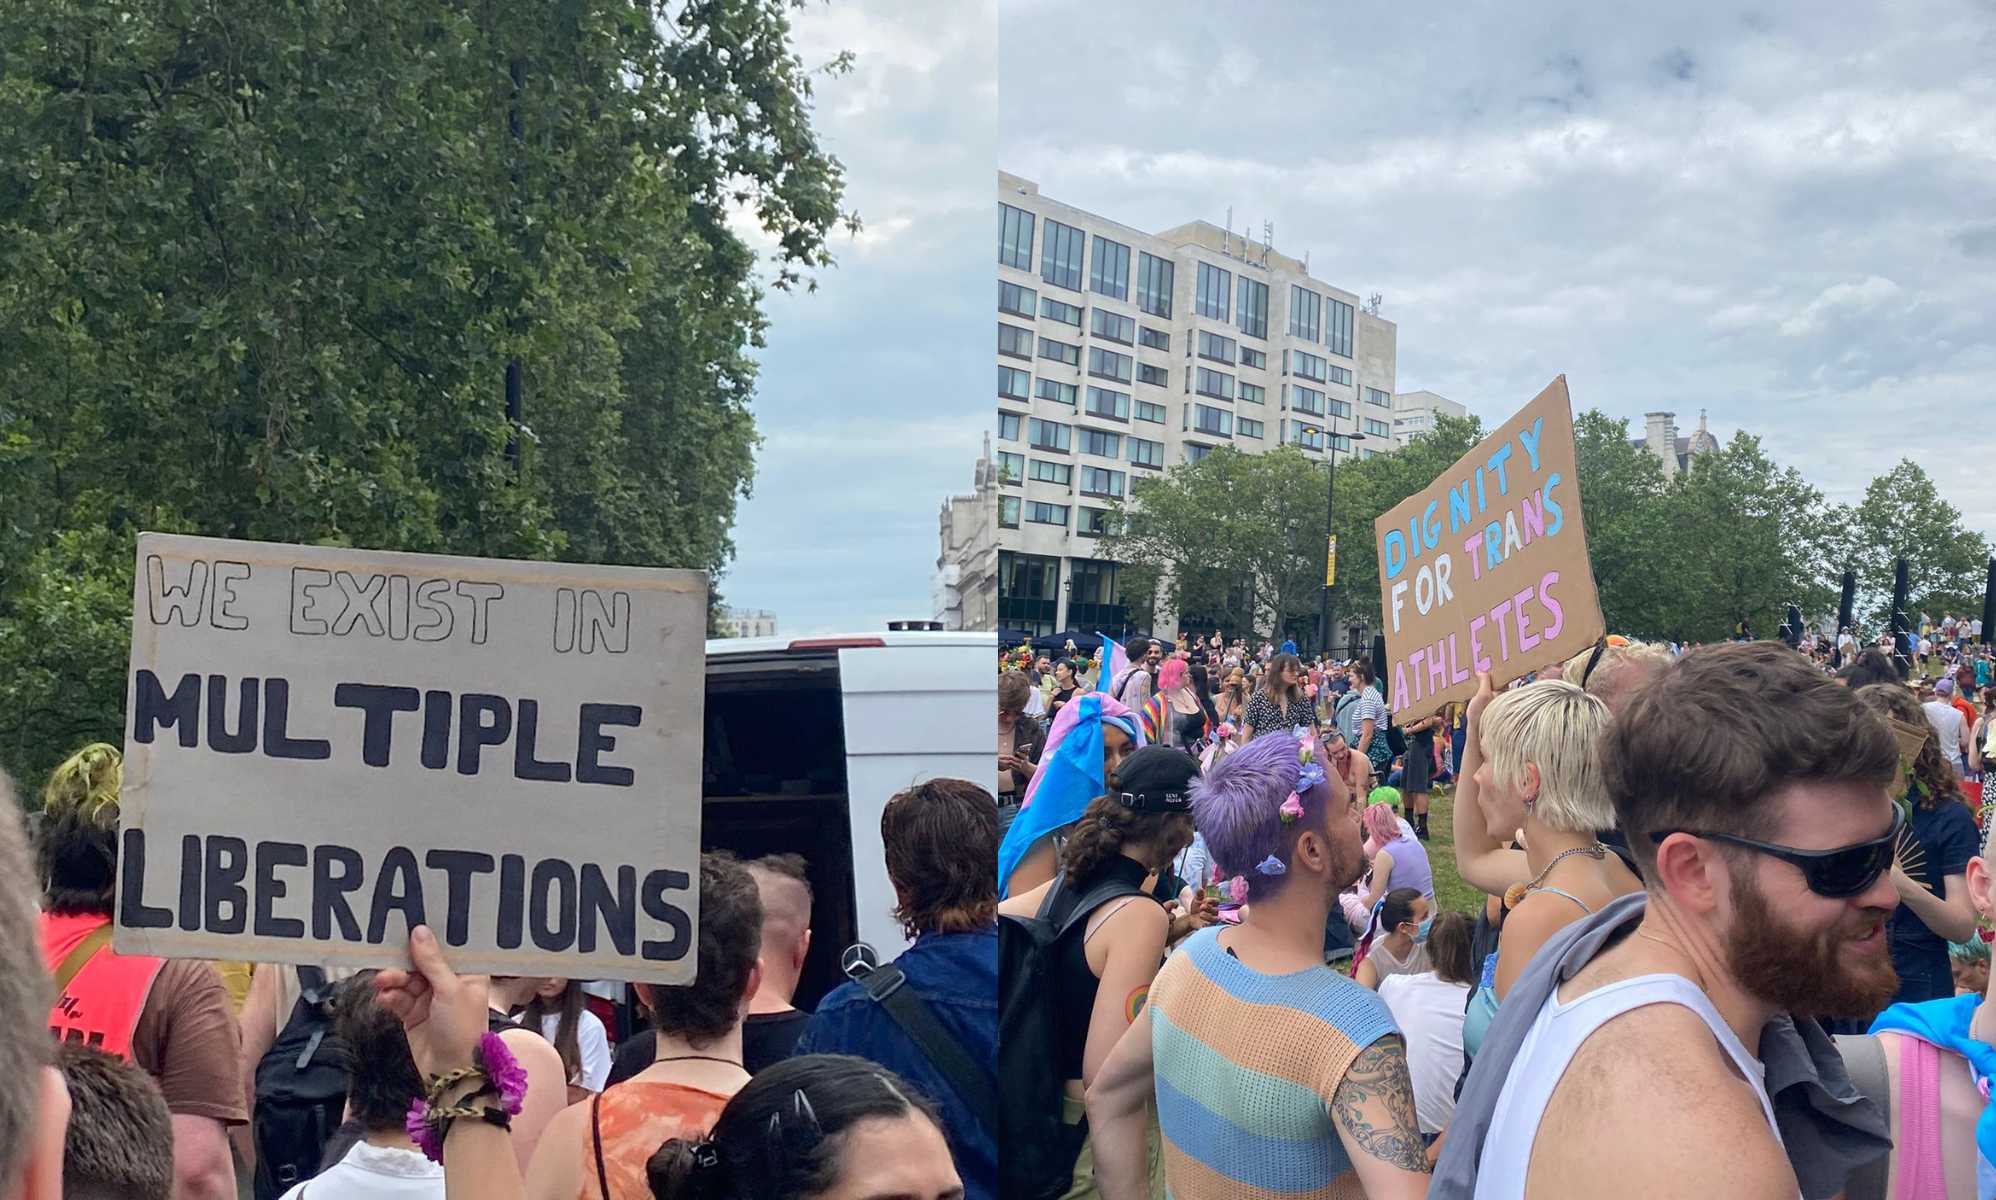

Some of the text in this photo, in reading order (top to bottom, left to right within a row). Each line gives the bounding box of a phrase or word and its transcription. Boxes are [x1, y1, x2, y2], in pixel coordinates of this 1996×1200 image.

[1384, 417, 1544, 580] DIGNITY
[1391, 553, 1454, 633] FOR
[1464, 473, 1564, 581] TRANS
[147, 555, 630, 653] WE EXIST IN
[1393, 571, 1565, 714] ATHLETES
[134, 669, 642, 786] MULTIPLE
[120, 828, 691, 961] LIBERATIONS
